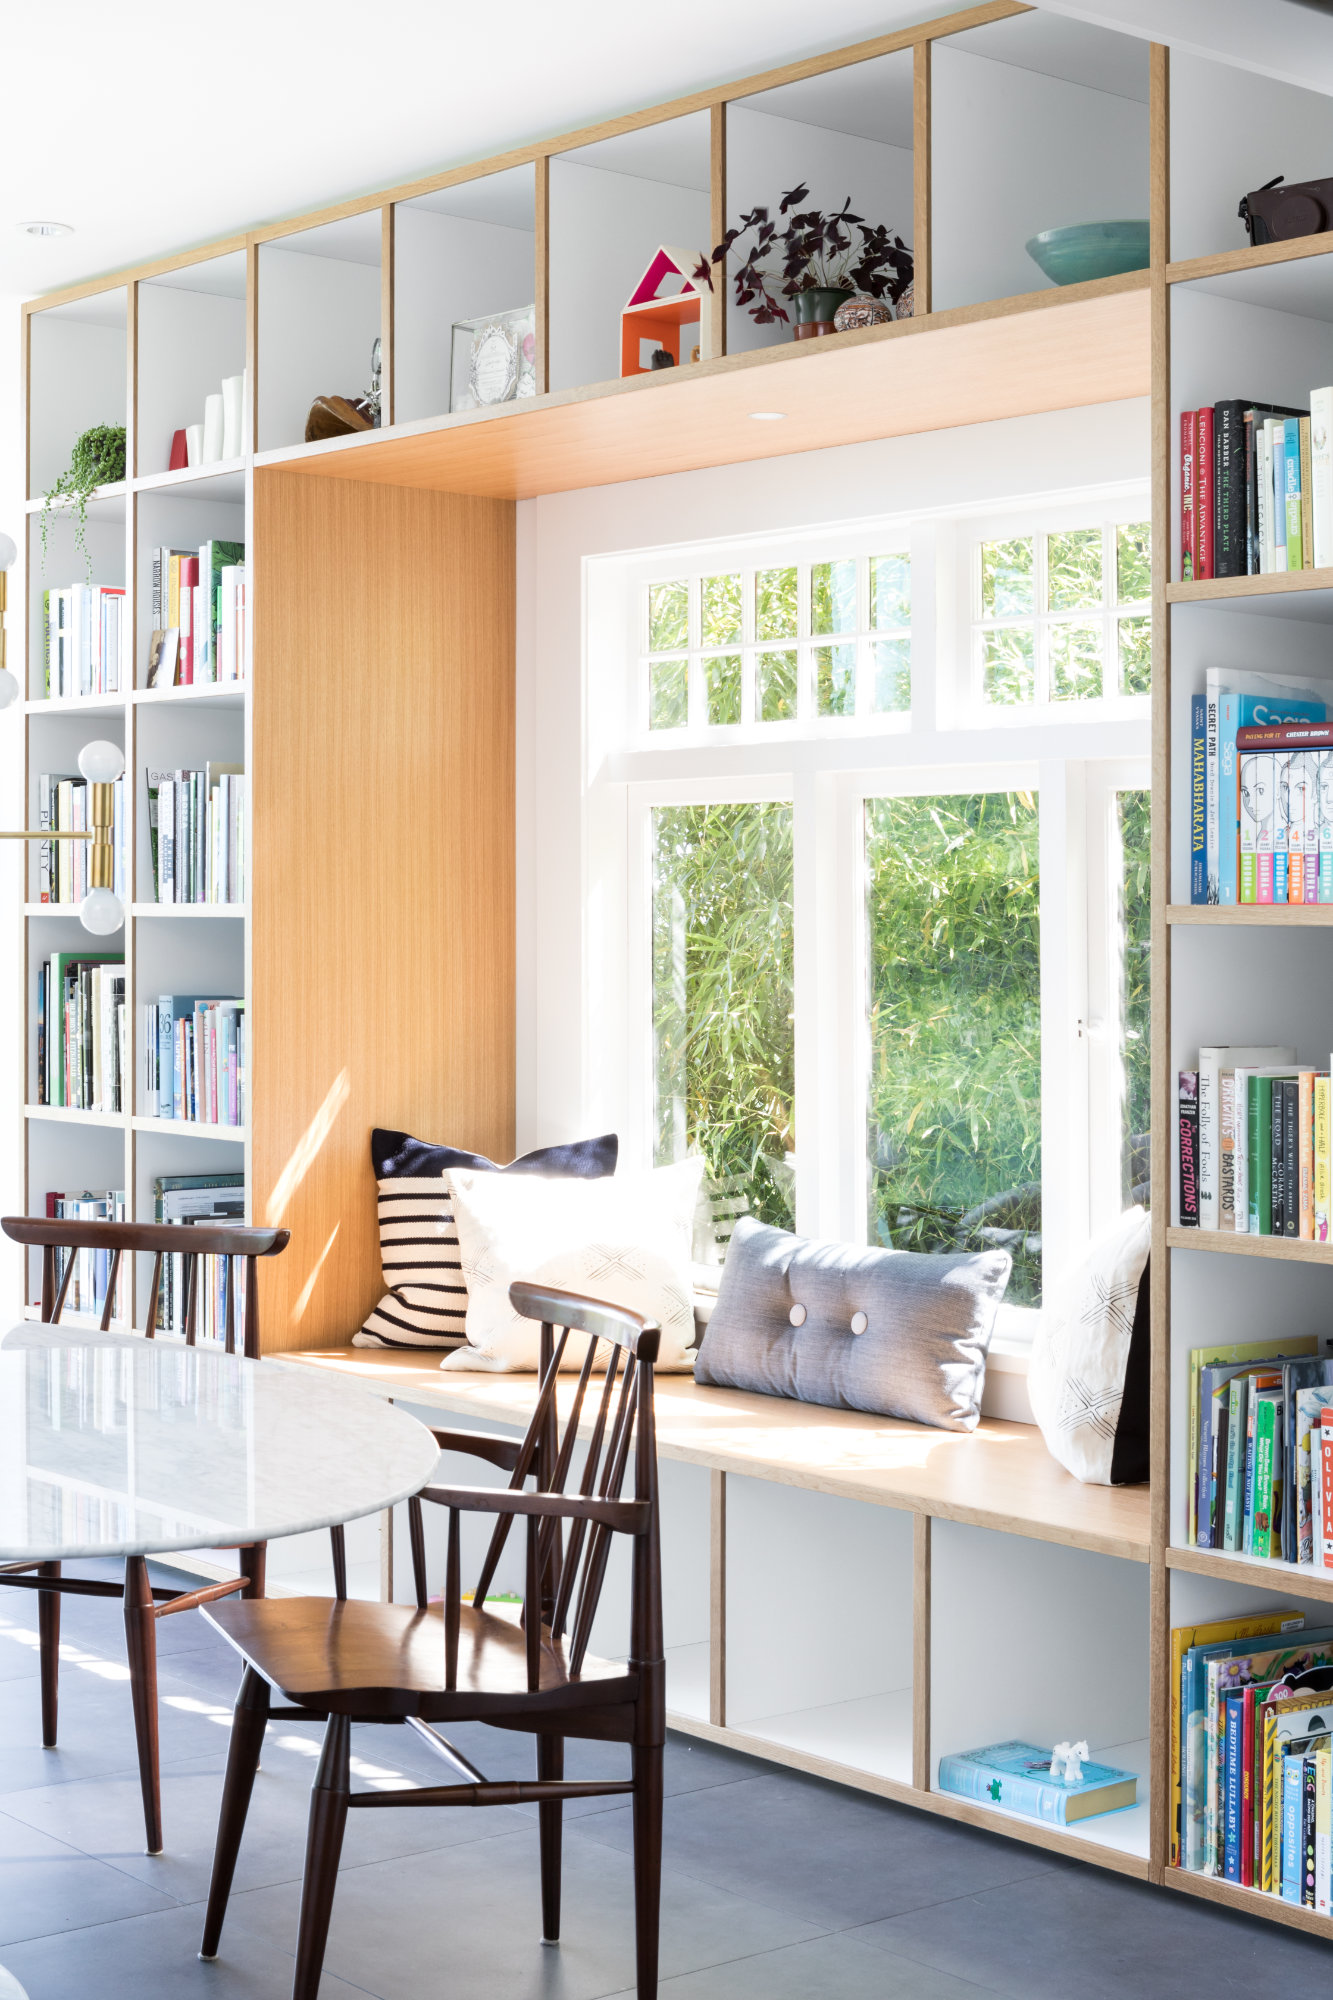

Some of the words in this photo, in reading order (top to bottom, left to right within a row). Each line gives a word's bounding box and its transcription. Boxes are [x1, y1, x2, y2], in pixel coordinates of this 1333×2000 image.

[1287, 458, 1297, 493] cradle
[1183, 494, 1193, 514] INC.
[152, 560, 161, 588] NARROW
[152, 590, 161, 615] HOUSES
[1208, 703, 1216, 732] SECRET
[1310, 729, 1330, 737] BROWN
[1208, 737, 1216, 756] PATH
[1222, 741, 1235, 776] Saga
[150, 771, 176, 782] GAS
[1193, 737, 1205, 852] MAHABHARATA
[41, 810, 49, 872] PLNTY
[1244, 830, 1251, 841] 1
[1260, 830, 1269, 841] 2
[1276, 828, 1285, 840] 3
[1291, 830, 1300, 841] 4
[1307, 830, 1315, 842] 5
[1323, 828, 1331, 840] 6
[160, 1013, 172, 1034] 36
[1201, 1074, 1211, 1097] The
[1199, 1101, 1211, 1130] Folly
[1221, 1078, 1235, 1136] DARWIN'S
[1201, 1133, 1211, 1147] of
[1180, 1118, 1197, 1213] CORRECTIONS
[1201, 1152, 1211, 1183] Fools
[1221, 1153, 1235, 1211] BASTARDS
[1324, 1446, 1333, 1533] OLIVIA
[1274, 1688, 1289, 1700] 300
[1307, 1766, 1316, 1793] EGG
[1287, 1806, 1297, 1868] opposites
